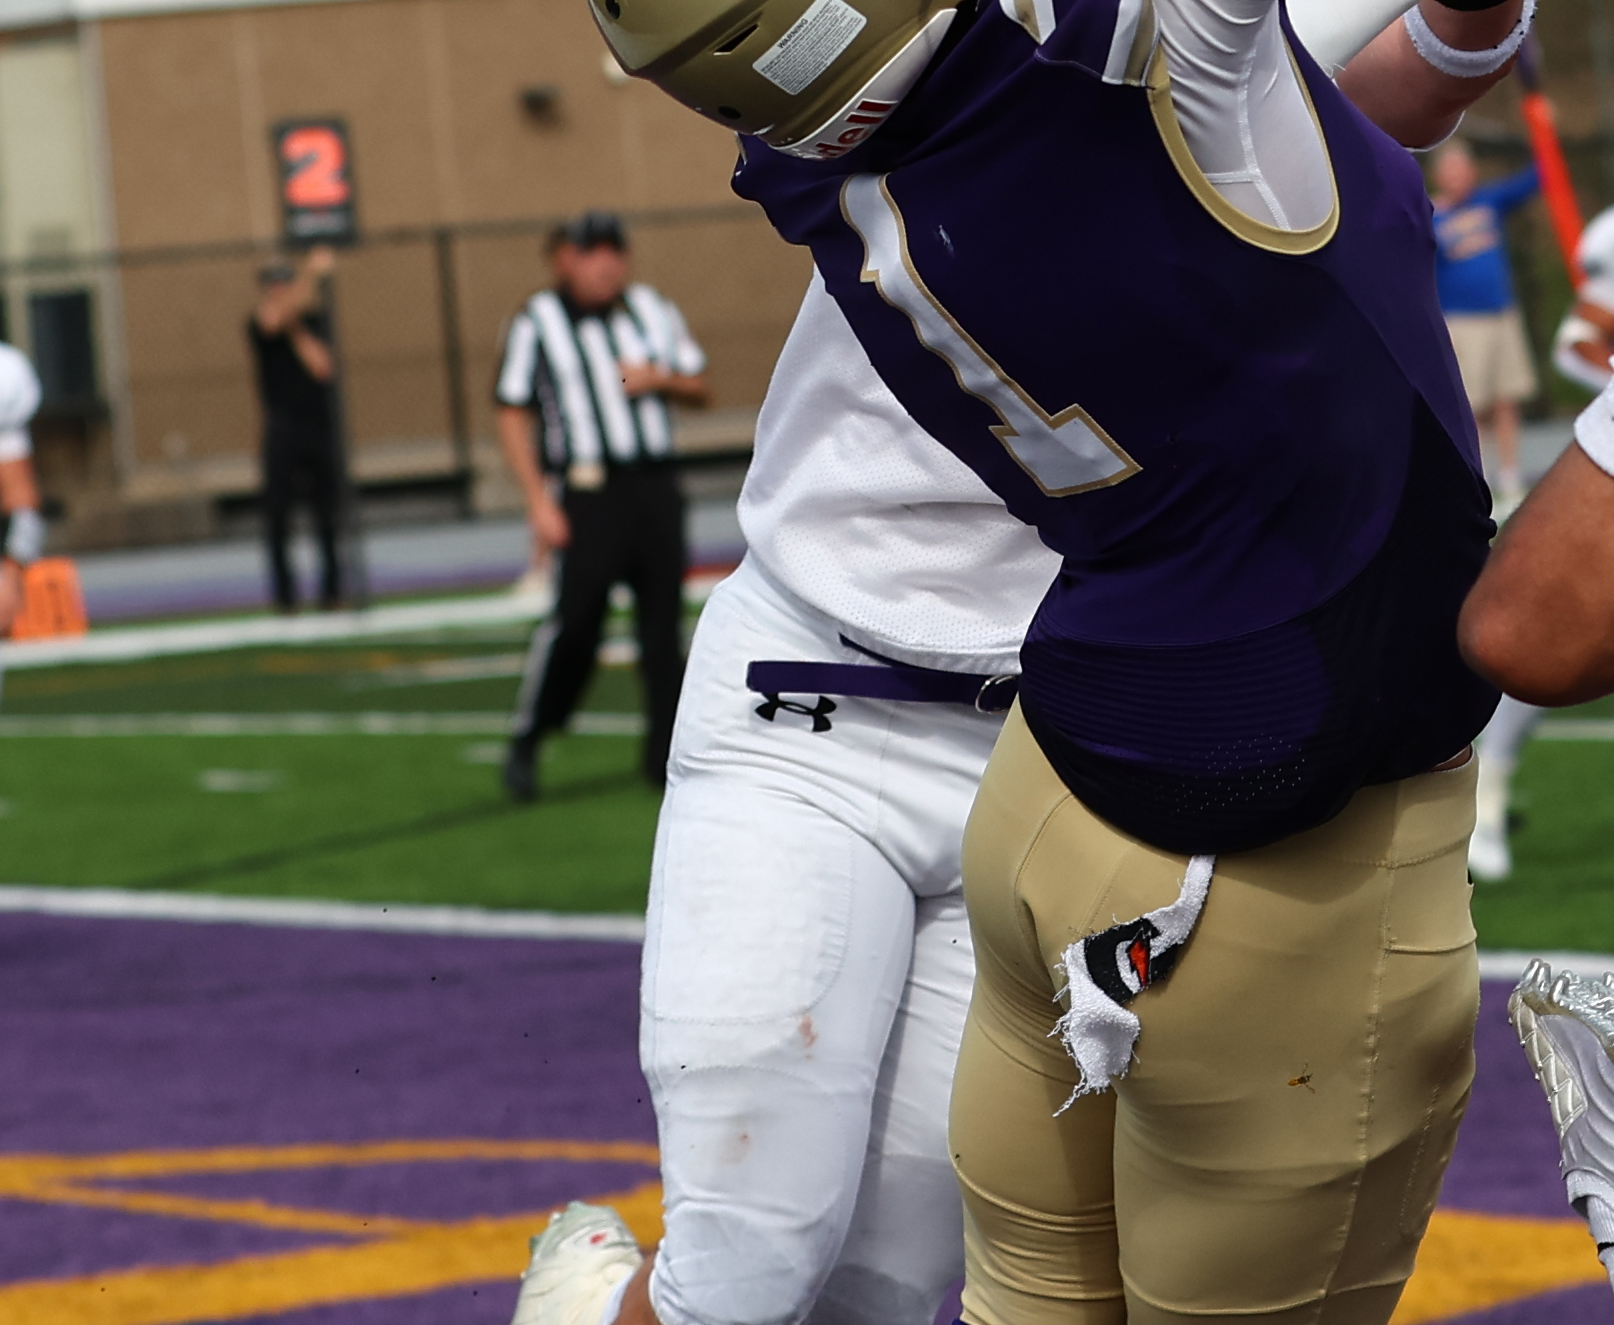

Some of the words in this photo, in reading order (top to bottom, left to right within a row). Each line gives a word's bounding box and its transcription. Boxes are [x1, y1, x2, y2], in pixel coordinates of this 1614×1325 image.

[777, 18, 809, 49] WARNING
[281, 126, 350, 207] 2
[839, 173, 1143, 497] 1
